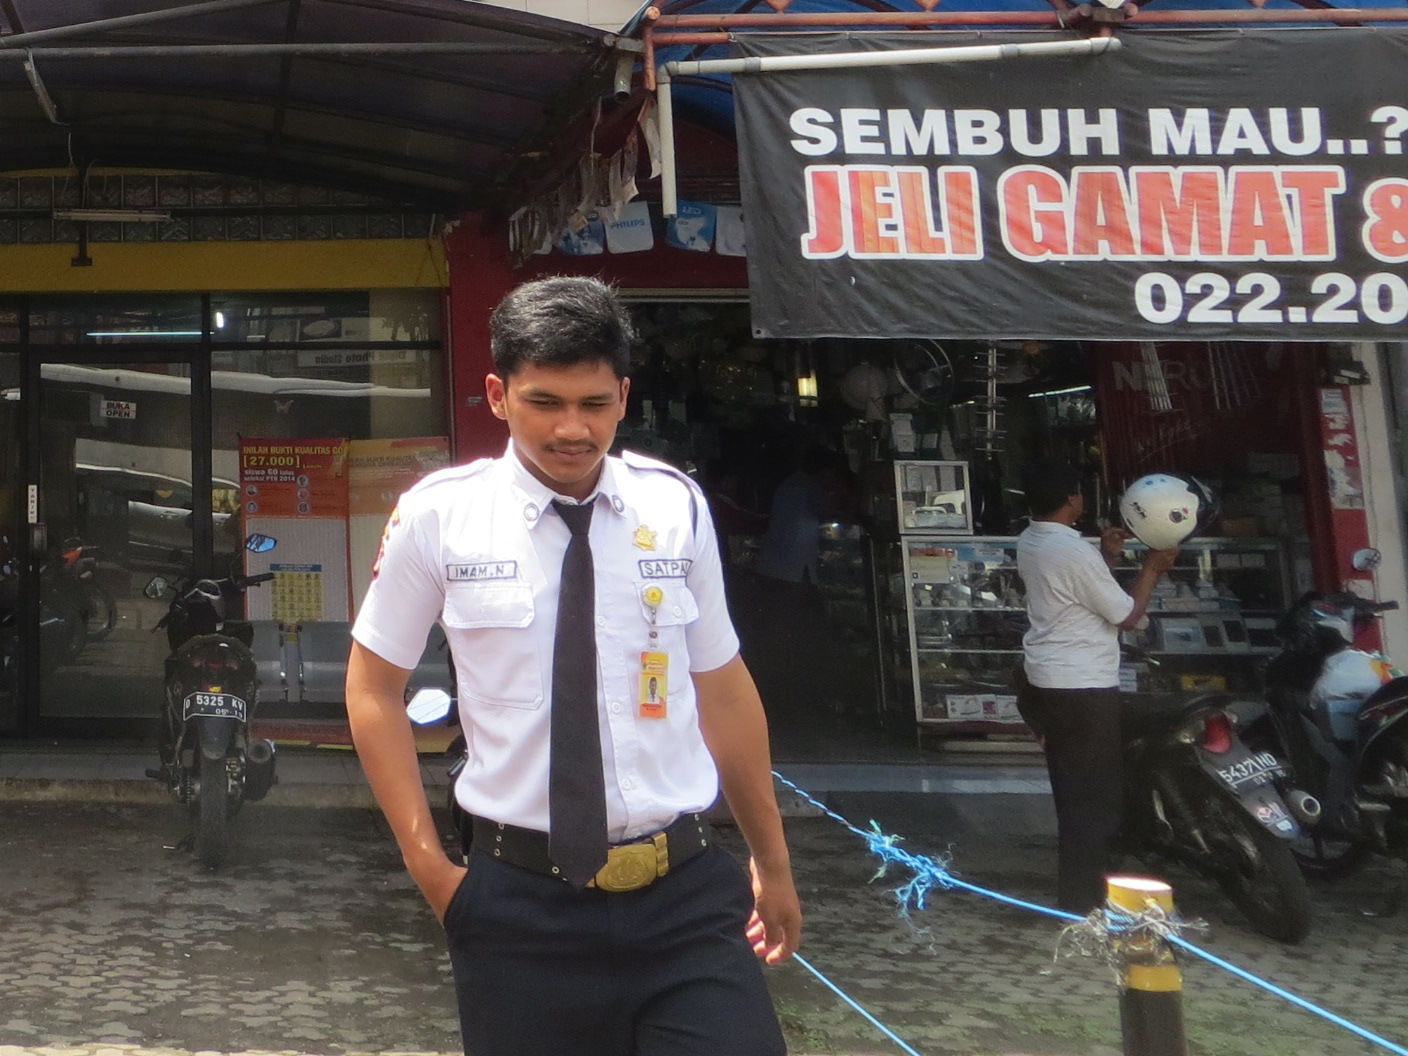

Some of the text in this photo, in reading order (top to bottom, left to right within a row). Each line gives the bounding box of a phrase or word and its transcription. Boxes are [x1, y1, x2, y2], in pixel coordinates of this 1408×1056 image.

[790, 107, 1121, 156] SEMBUH
[801, 165, 984, 260] JELI
[998, 165, 1347, 262] GAMAT
[106, 401, 130, 410] BUKA
[106, 410, 130, 418] OPEN
[196, 695, 224, 706] 5325
